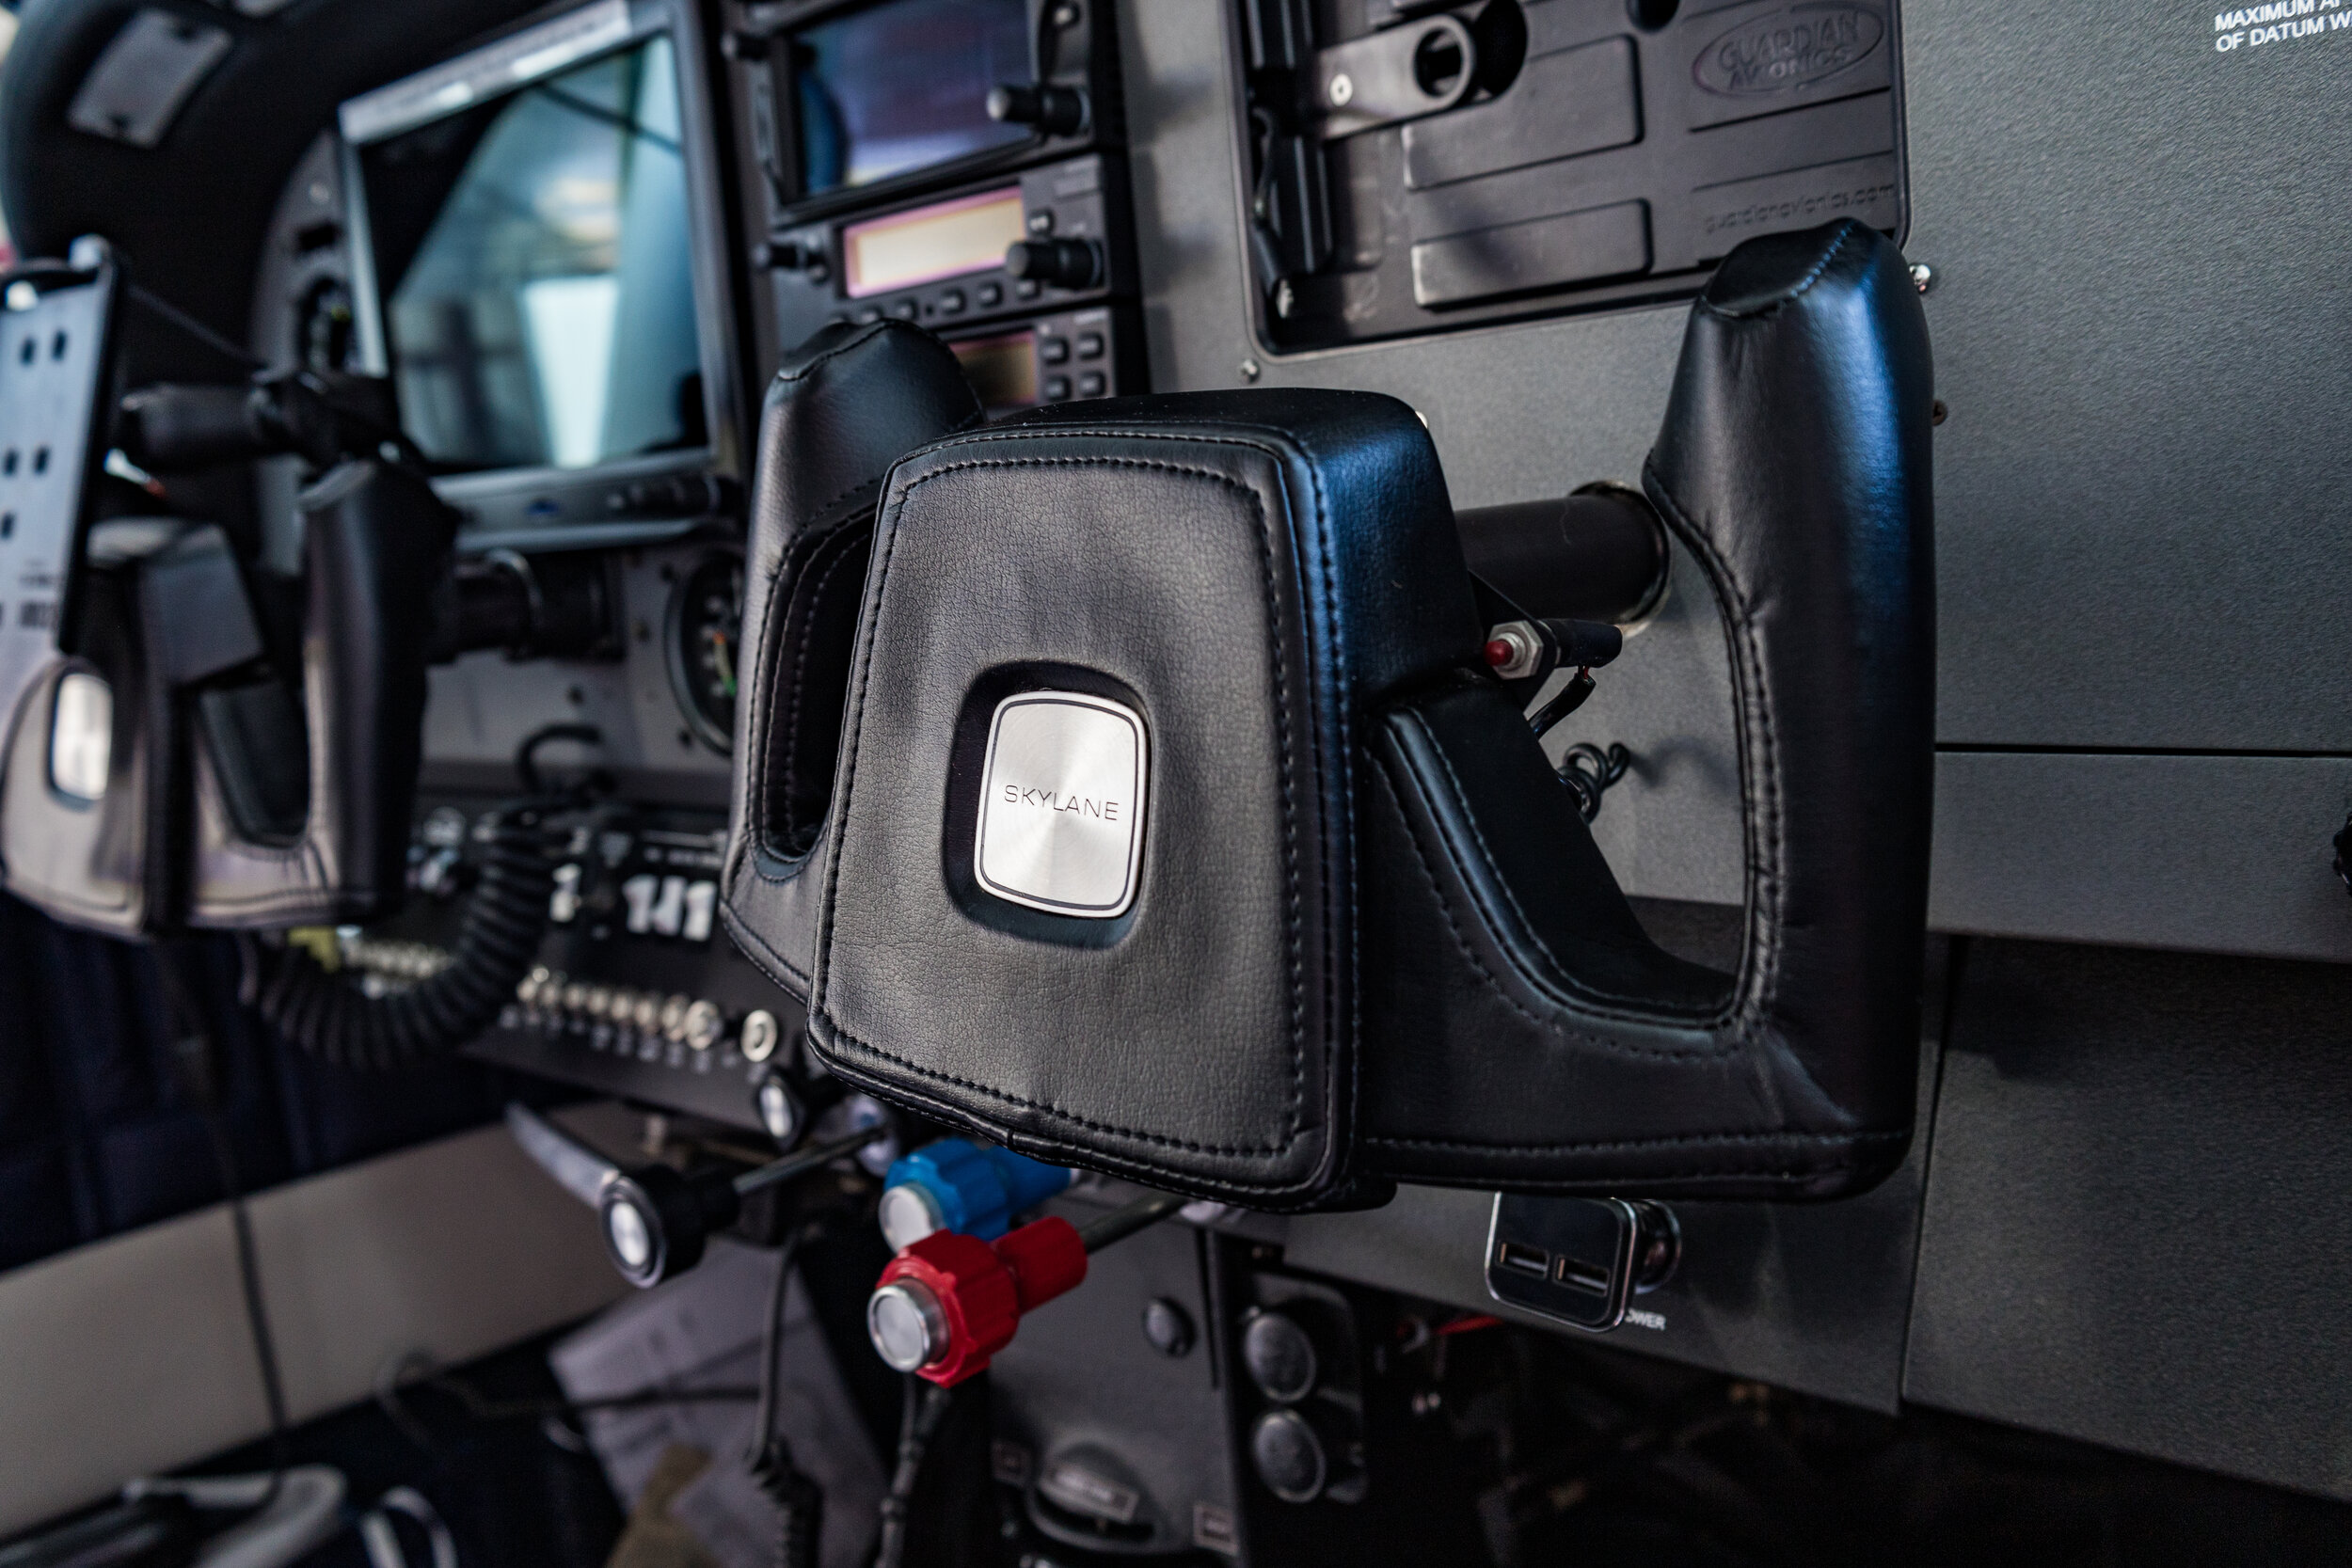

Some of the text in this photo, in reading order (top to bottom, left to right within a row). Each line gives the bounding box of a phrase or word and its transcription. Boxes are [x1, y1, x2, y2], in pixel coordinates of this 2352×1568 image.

[2215, 0, 2314, 31] MAXIMUM
[2216, 31, 2245, 53] OF
[2249, 15, 2324, 46] DATUM
[1719, 10, 1860, 71] GUARDIAN
[1004, 784, 1119, 821] SKYLANE
